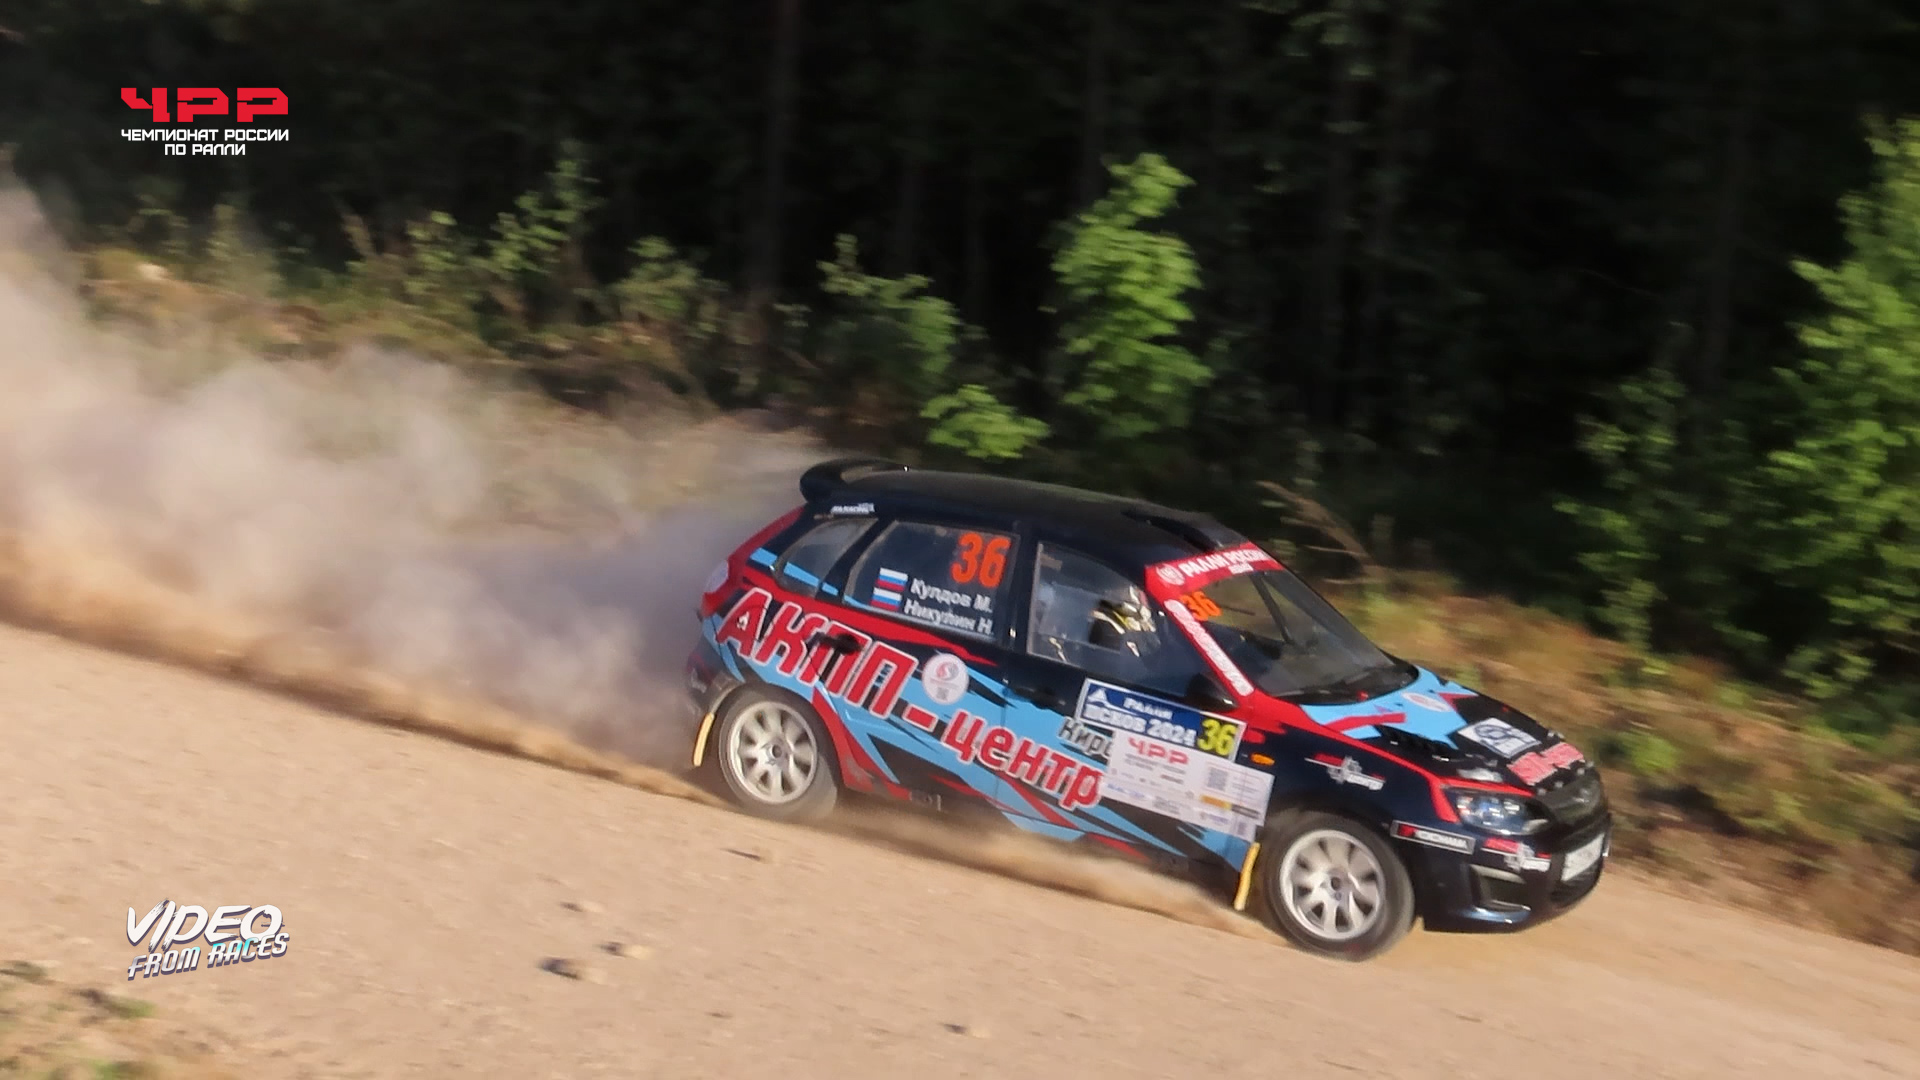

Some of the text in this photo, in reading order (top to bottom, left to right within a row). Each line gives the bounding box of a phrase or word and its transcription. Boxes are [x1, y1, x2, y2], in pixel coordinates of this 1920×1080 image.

[952, 532, 1011, 588] 36
[1180, 590, 1222, 621] 36
[1128, 737, 1189, 765] ЧРР
[1197, 719, 1238, 756] 36
